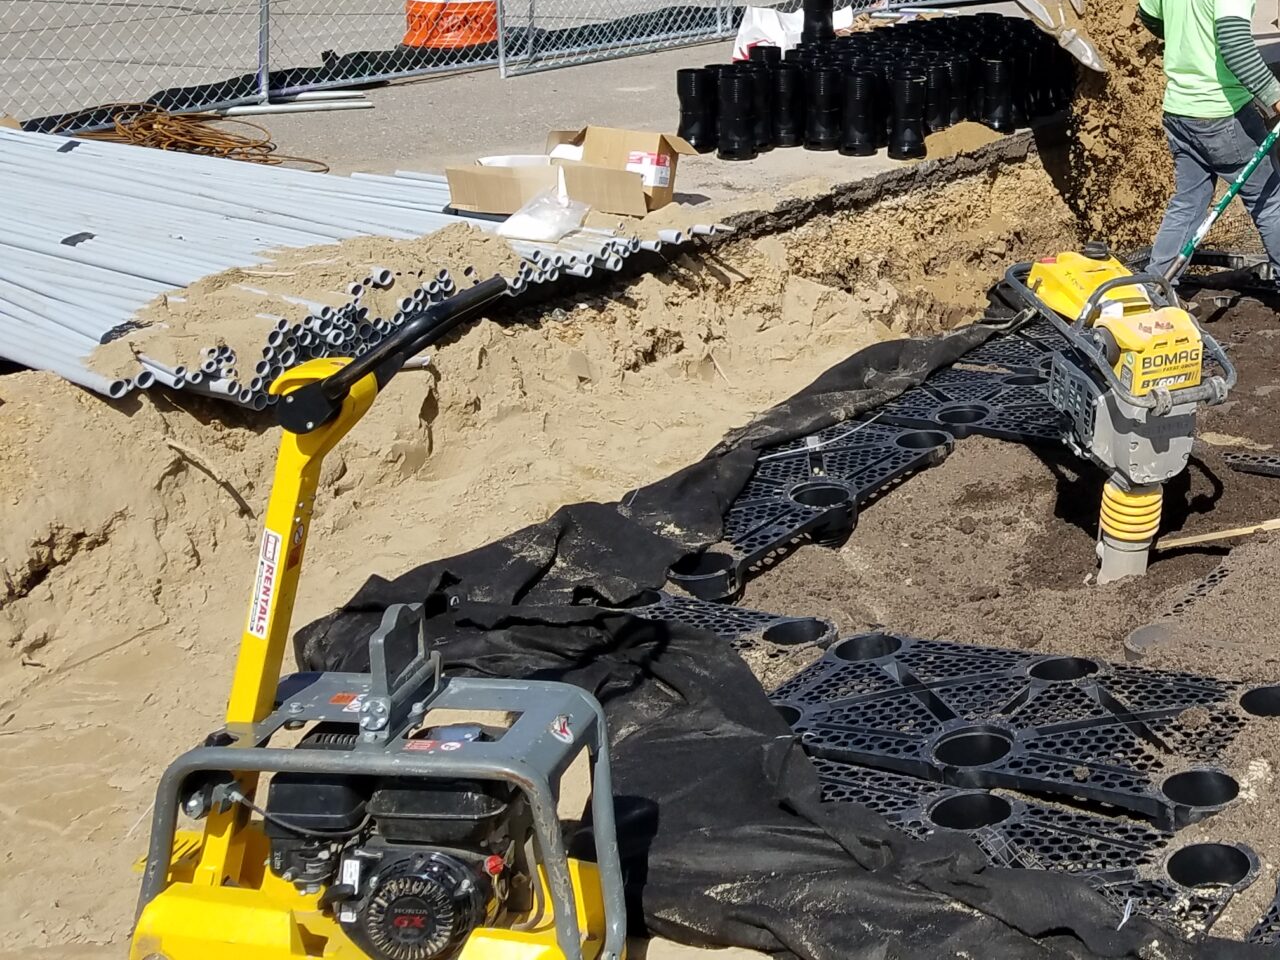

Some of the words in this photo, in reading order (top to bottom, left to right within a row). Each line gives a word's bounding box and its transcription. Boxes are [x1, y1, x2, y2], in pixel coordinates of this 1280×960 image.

[1142, 349, 1200, 369] BOMAG
[255, 564, 275, 635] RENTALS
[393, 915, 426, 928] GX
